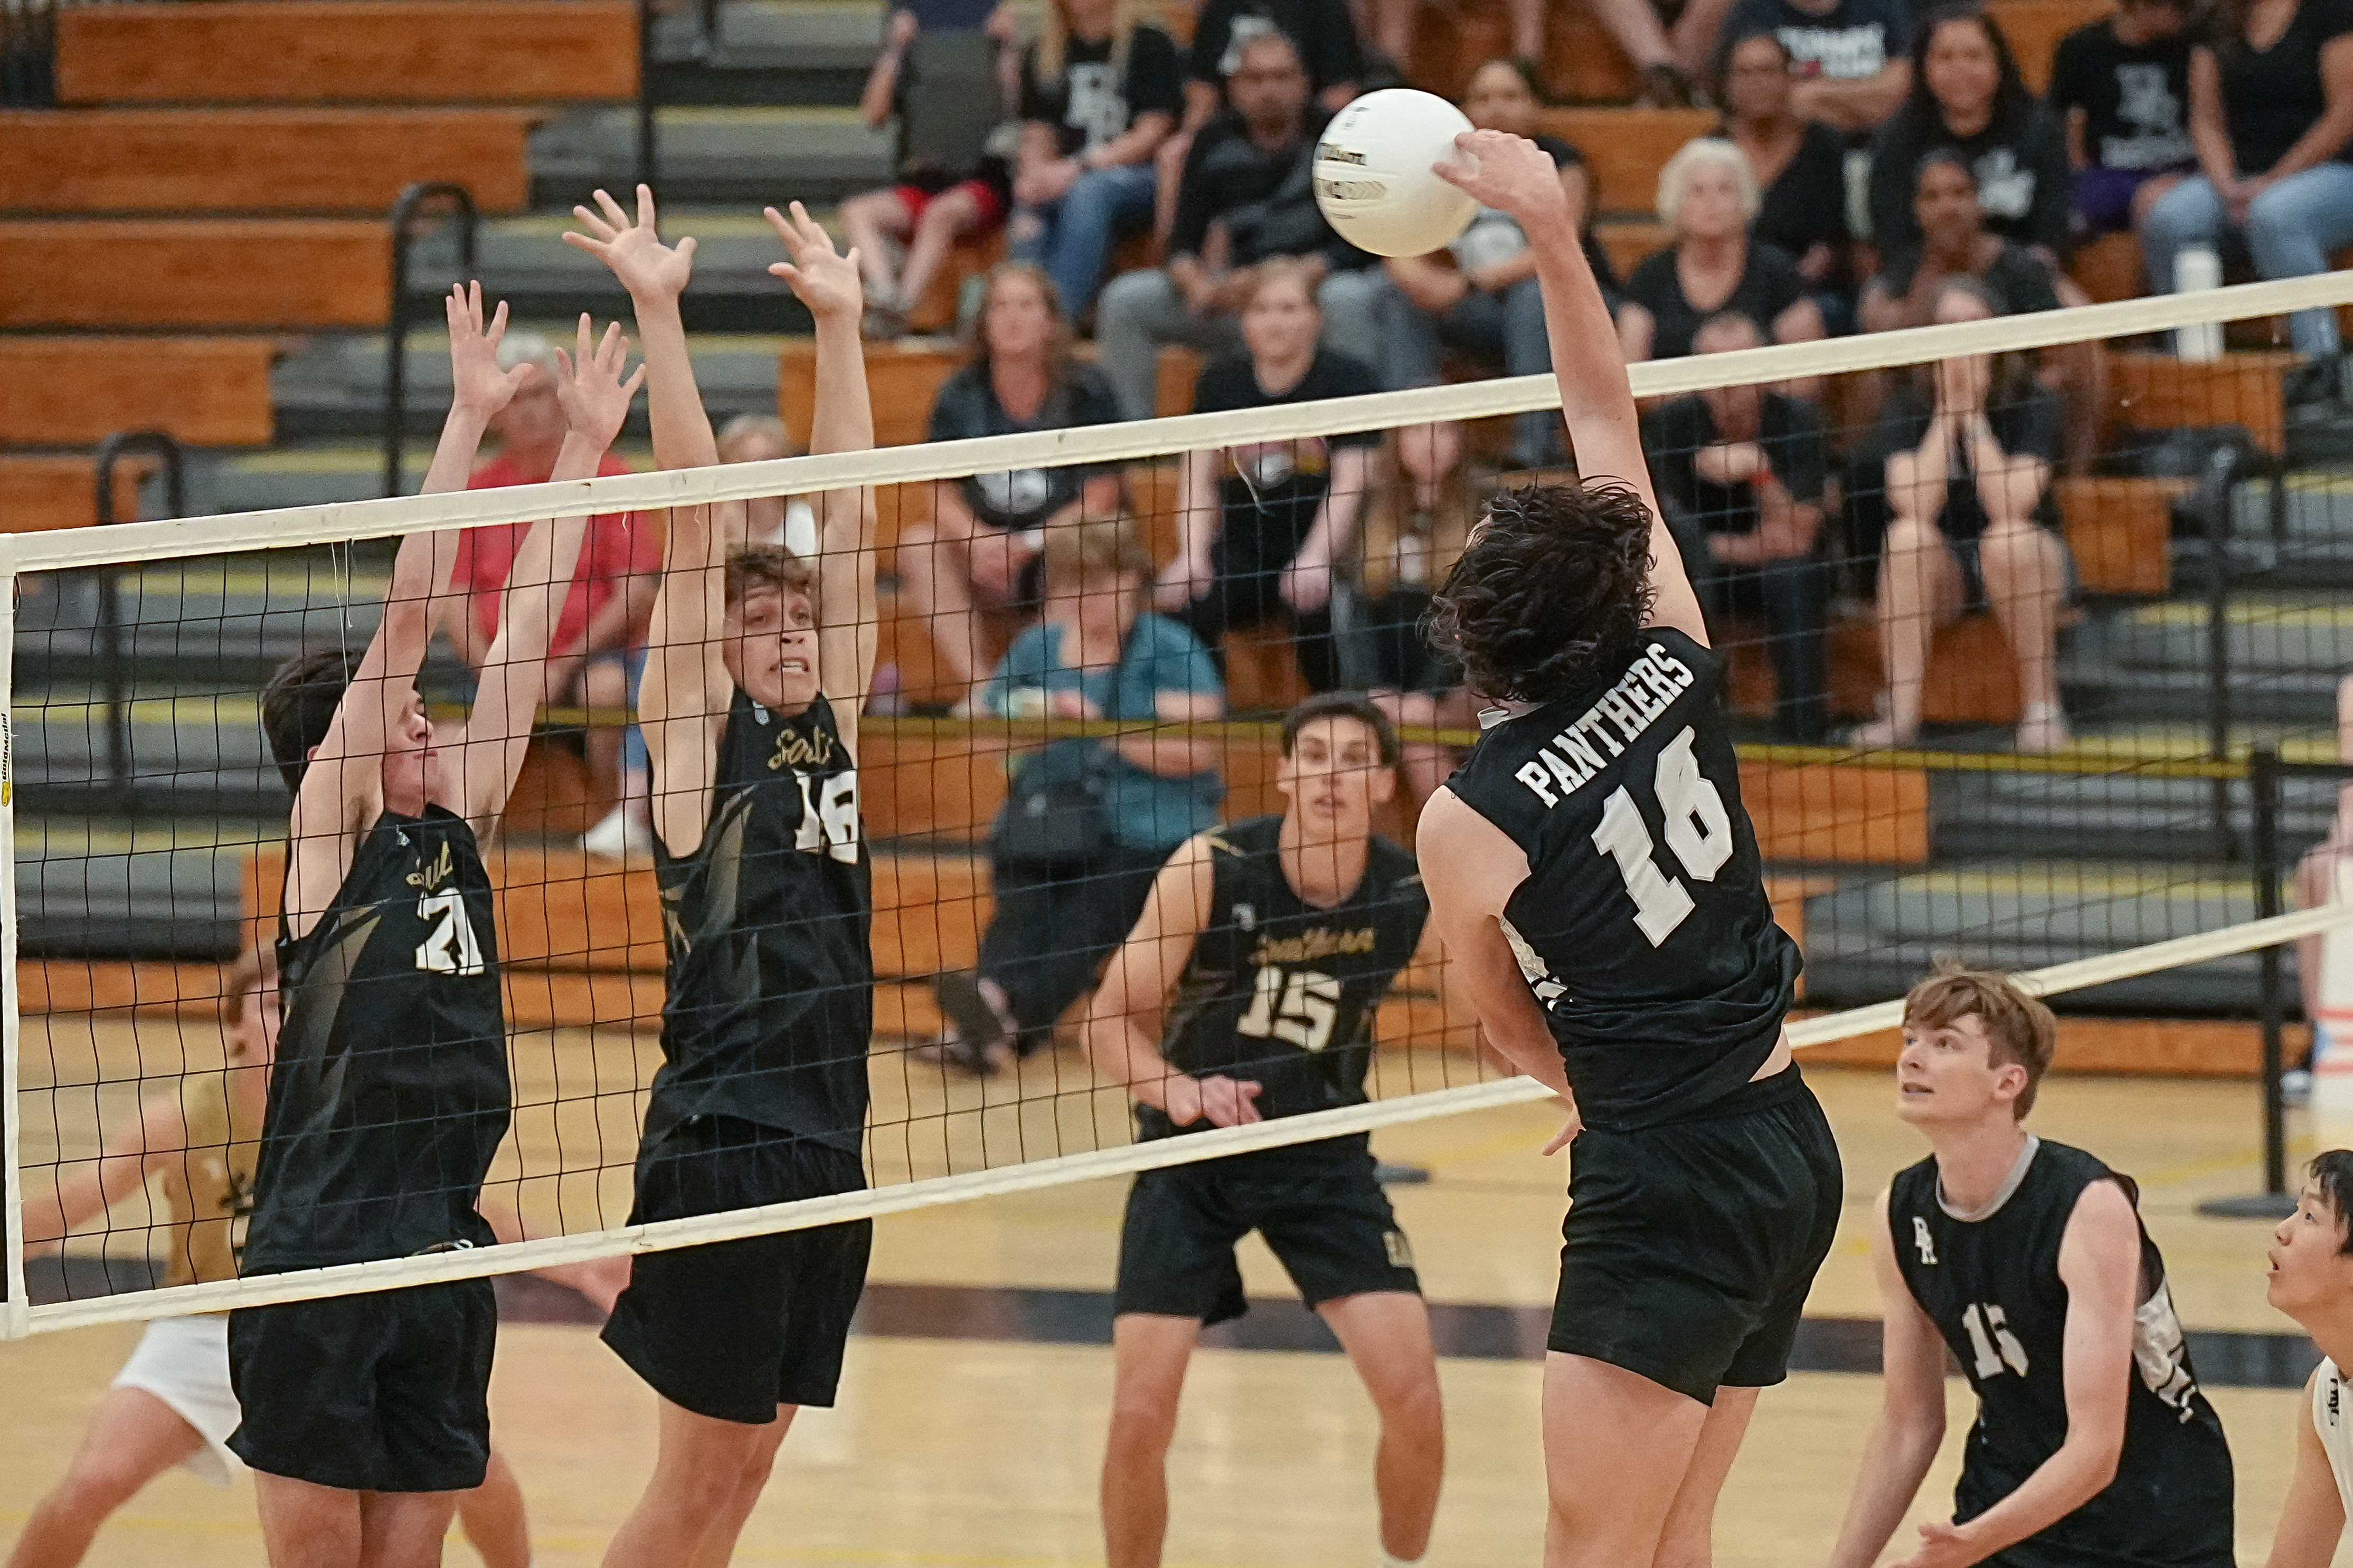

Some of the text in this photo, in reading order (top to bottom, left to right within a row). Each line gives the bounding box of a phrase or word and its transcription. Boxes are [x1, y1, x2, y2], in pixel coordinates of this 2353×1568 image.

[1515, 643, 1694, 809] PANTHERS
[1591, 725, 1733, 948] 16
[1237, 966, 1343, 1052] 15
